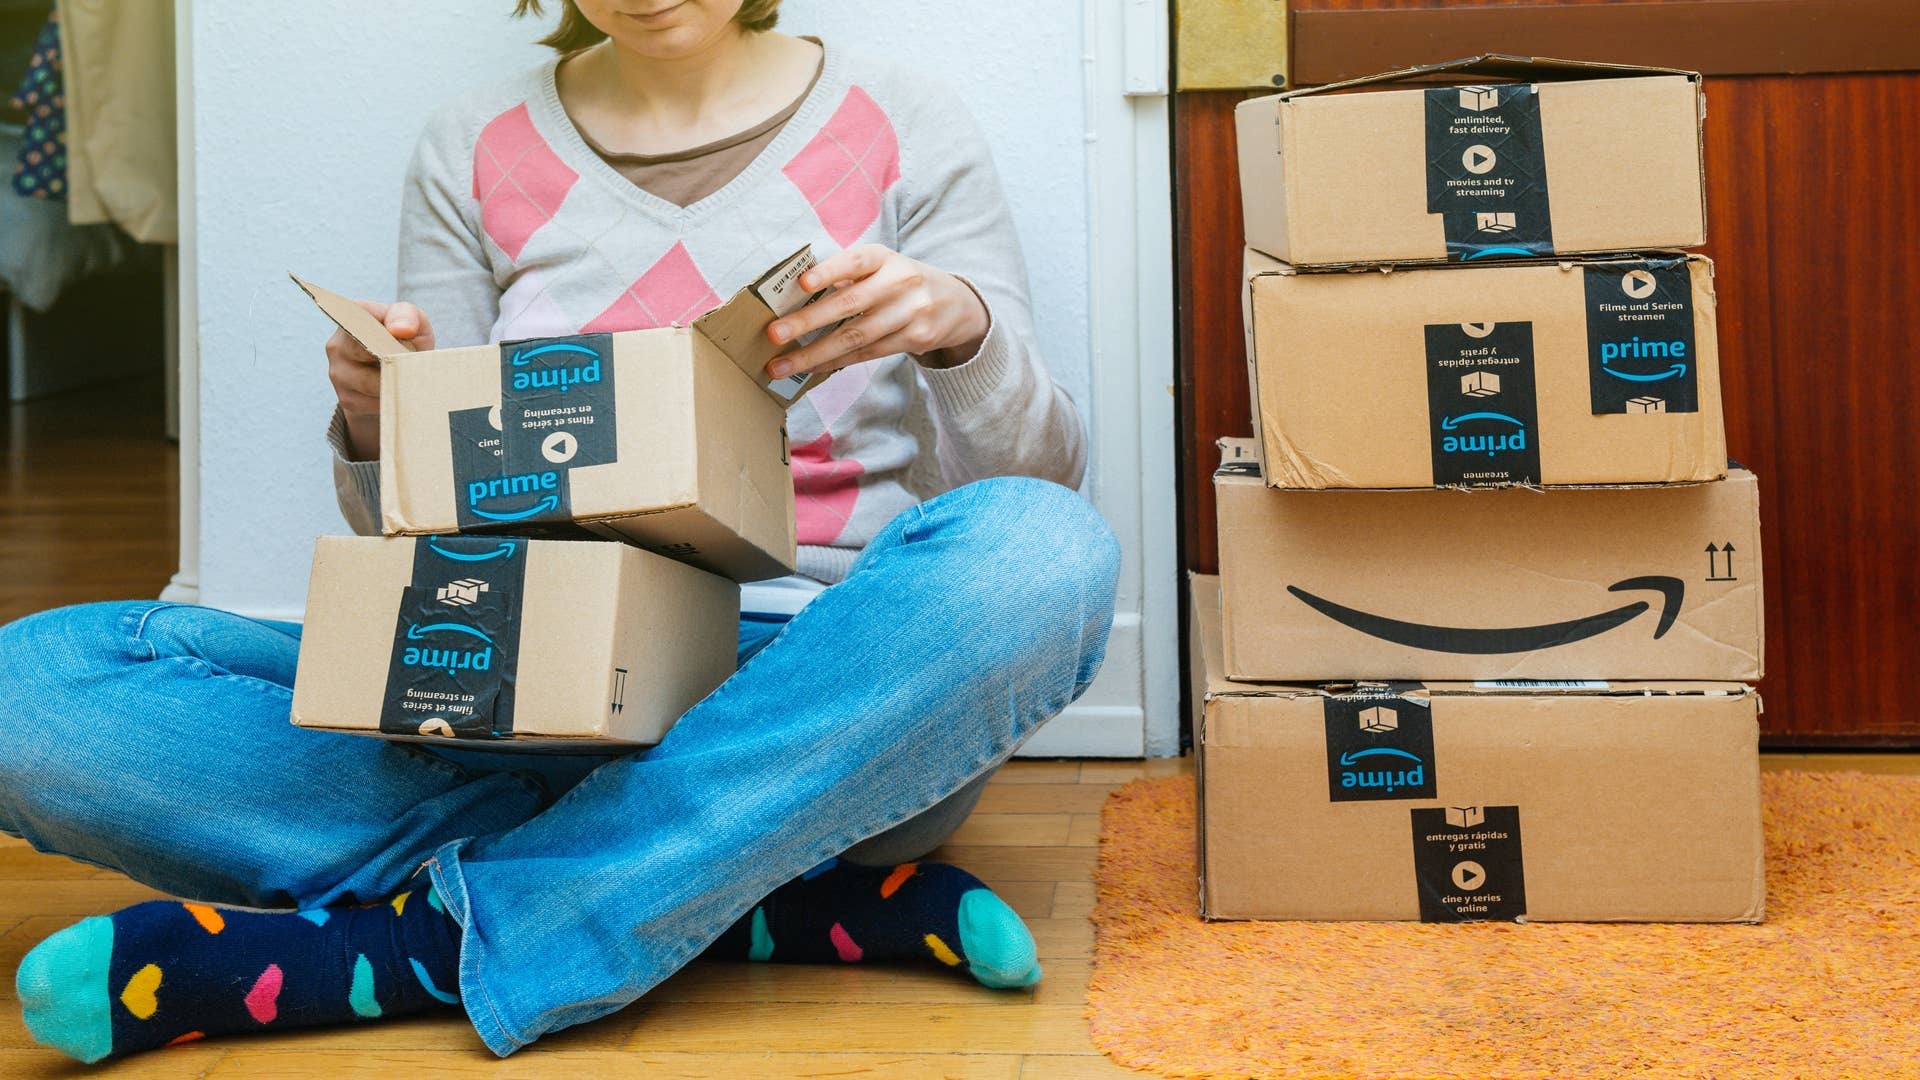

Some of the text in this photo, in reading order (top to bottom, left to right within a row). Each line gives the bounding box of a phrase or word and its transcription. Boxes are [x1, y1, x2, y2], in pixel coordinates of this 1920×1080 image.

[1454, 116, 1505, 125] unlimited,
[1449, 125, 1510, 135] fast delivery
[1483, 178, 1502, 186] and
[1456, 188, 1505, 197] streaming
[1599, 302, 1683, 311] Filme und Serien
[1618, 313, 1665, 321] streamen
[1460, 347, 1497, 358] y gratis
[1601, 336, 1686, 364] prime
[1438, 357, 1520, 368] entregas rápidas
[513, 360, 601, 391] prime
[524, 405, 592, 418] en streaming
[522, 416, 594, 430] films et séries
[478, 438, 500, 448] cine
[1442, 429, 1526, 457] prime
[1463, 471, 1509, 480] streamen
[469, 471, 558, 506] prime
[403, 646, 492, 675] prime
[407, 689, 475, 703] en streaming
[402, 701, 474, 715] films et séries
[1341, 765, 1424, 792] prime
[1426, 831, 1508, 842] entregas rápidas
[1449, 841, 1486, 852] y gratis
[1442, 894, 1502, 904] cine y series
[1456, 904, 1488, 913] online
